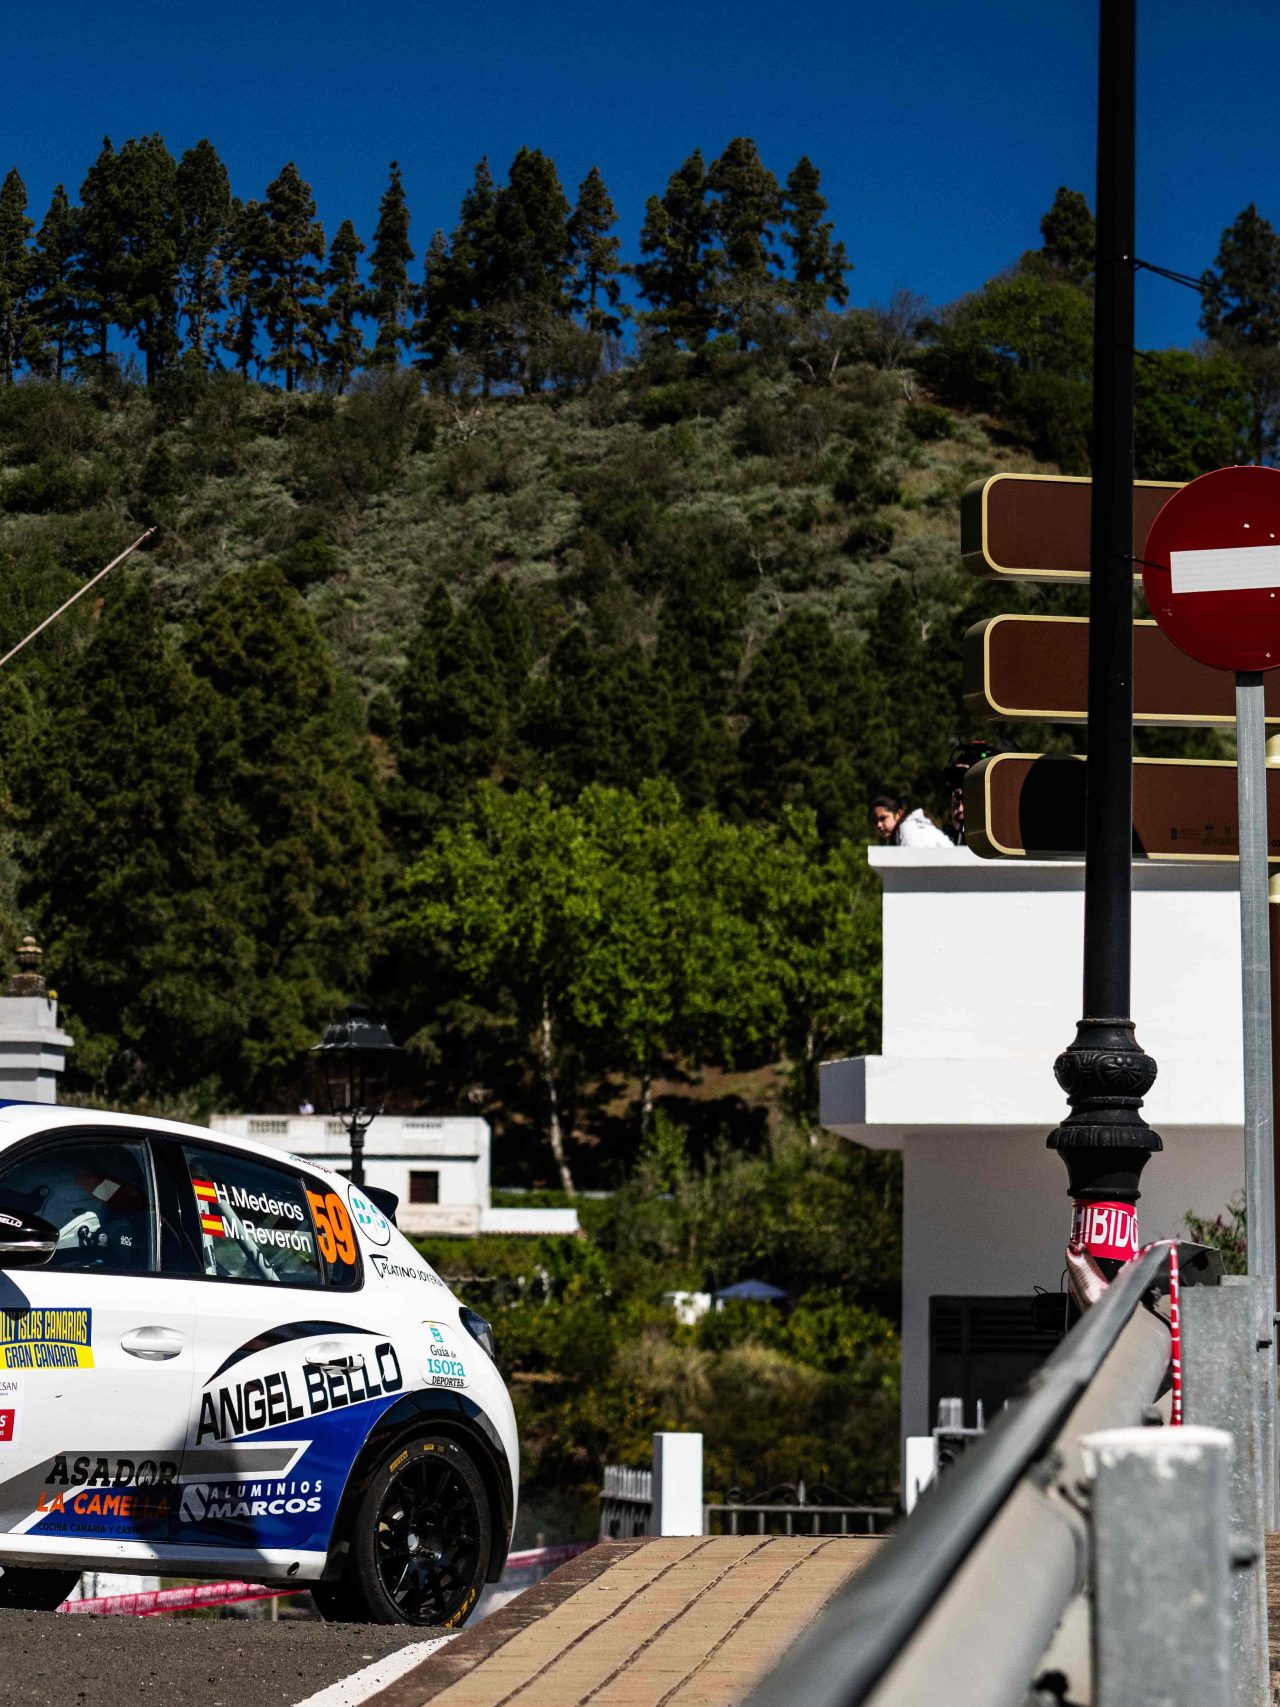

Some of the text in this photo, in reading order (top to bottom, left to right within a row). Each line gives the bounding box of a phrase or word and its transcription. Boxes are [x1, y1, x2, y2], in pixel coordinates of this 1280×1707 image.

[213, 1182, 304, 1221] H.Mederos
[221, 1216, 312, 1253] M.Reverón
[307, 1190, 356, 1265] 59
[381, 1264, 417, 1284] PLATINO
[18, 1311, 42, 1340] ISLAS
[44, 1311, 87, 1344] CANARIAS
[4, 1344, 79, 1368] GRAN CANARIA
[196, 1343, 403, 1446] ANGEL BELLO
[431, 1376, 465, 1387] DEPORTES
[45, 1455, 178, 1489] ASADOR
[36, 1490, 65, 1513] LA
[210, 1480, 322, 1500] ALUMINIOS
[207, 1497, 322, 1518] MARCOS
